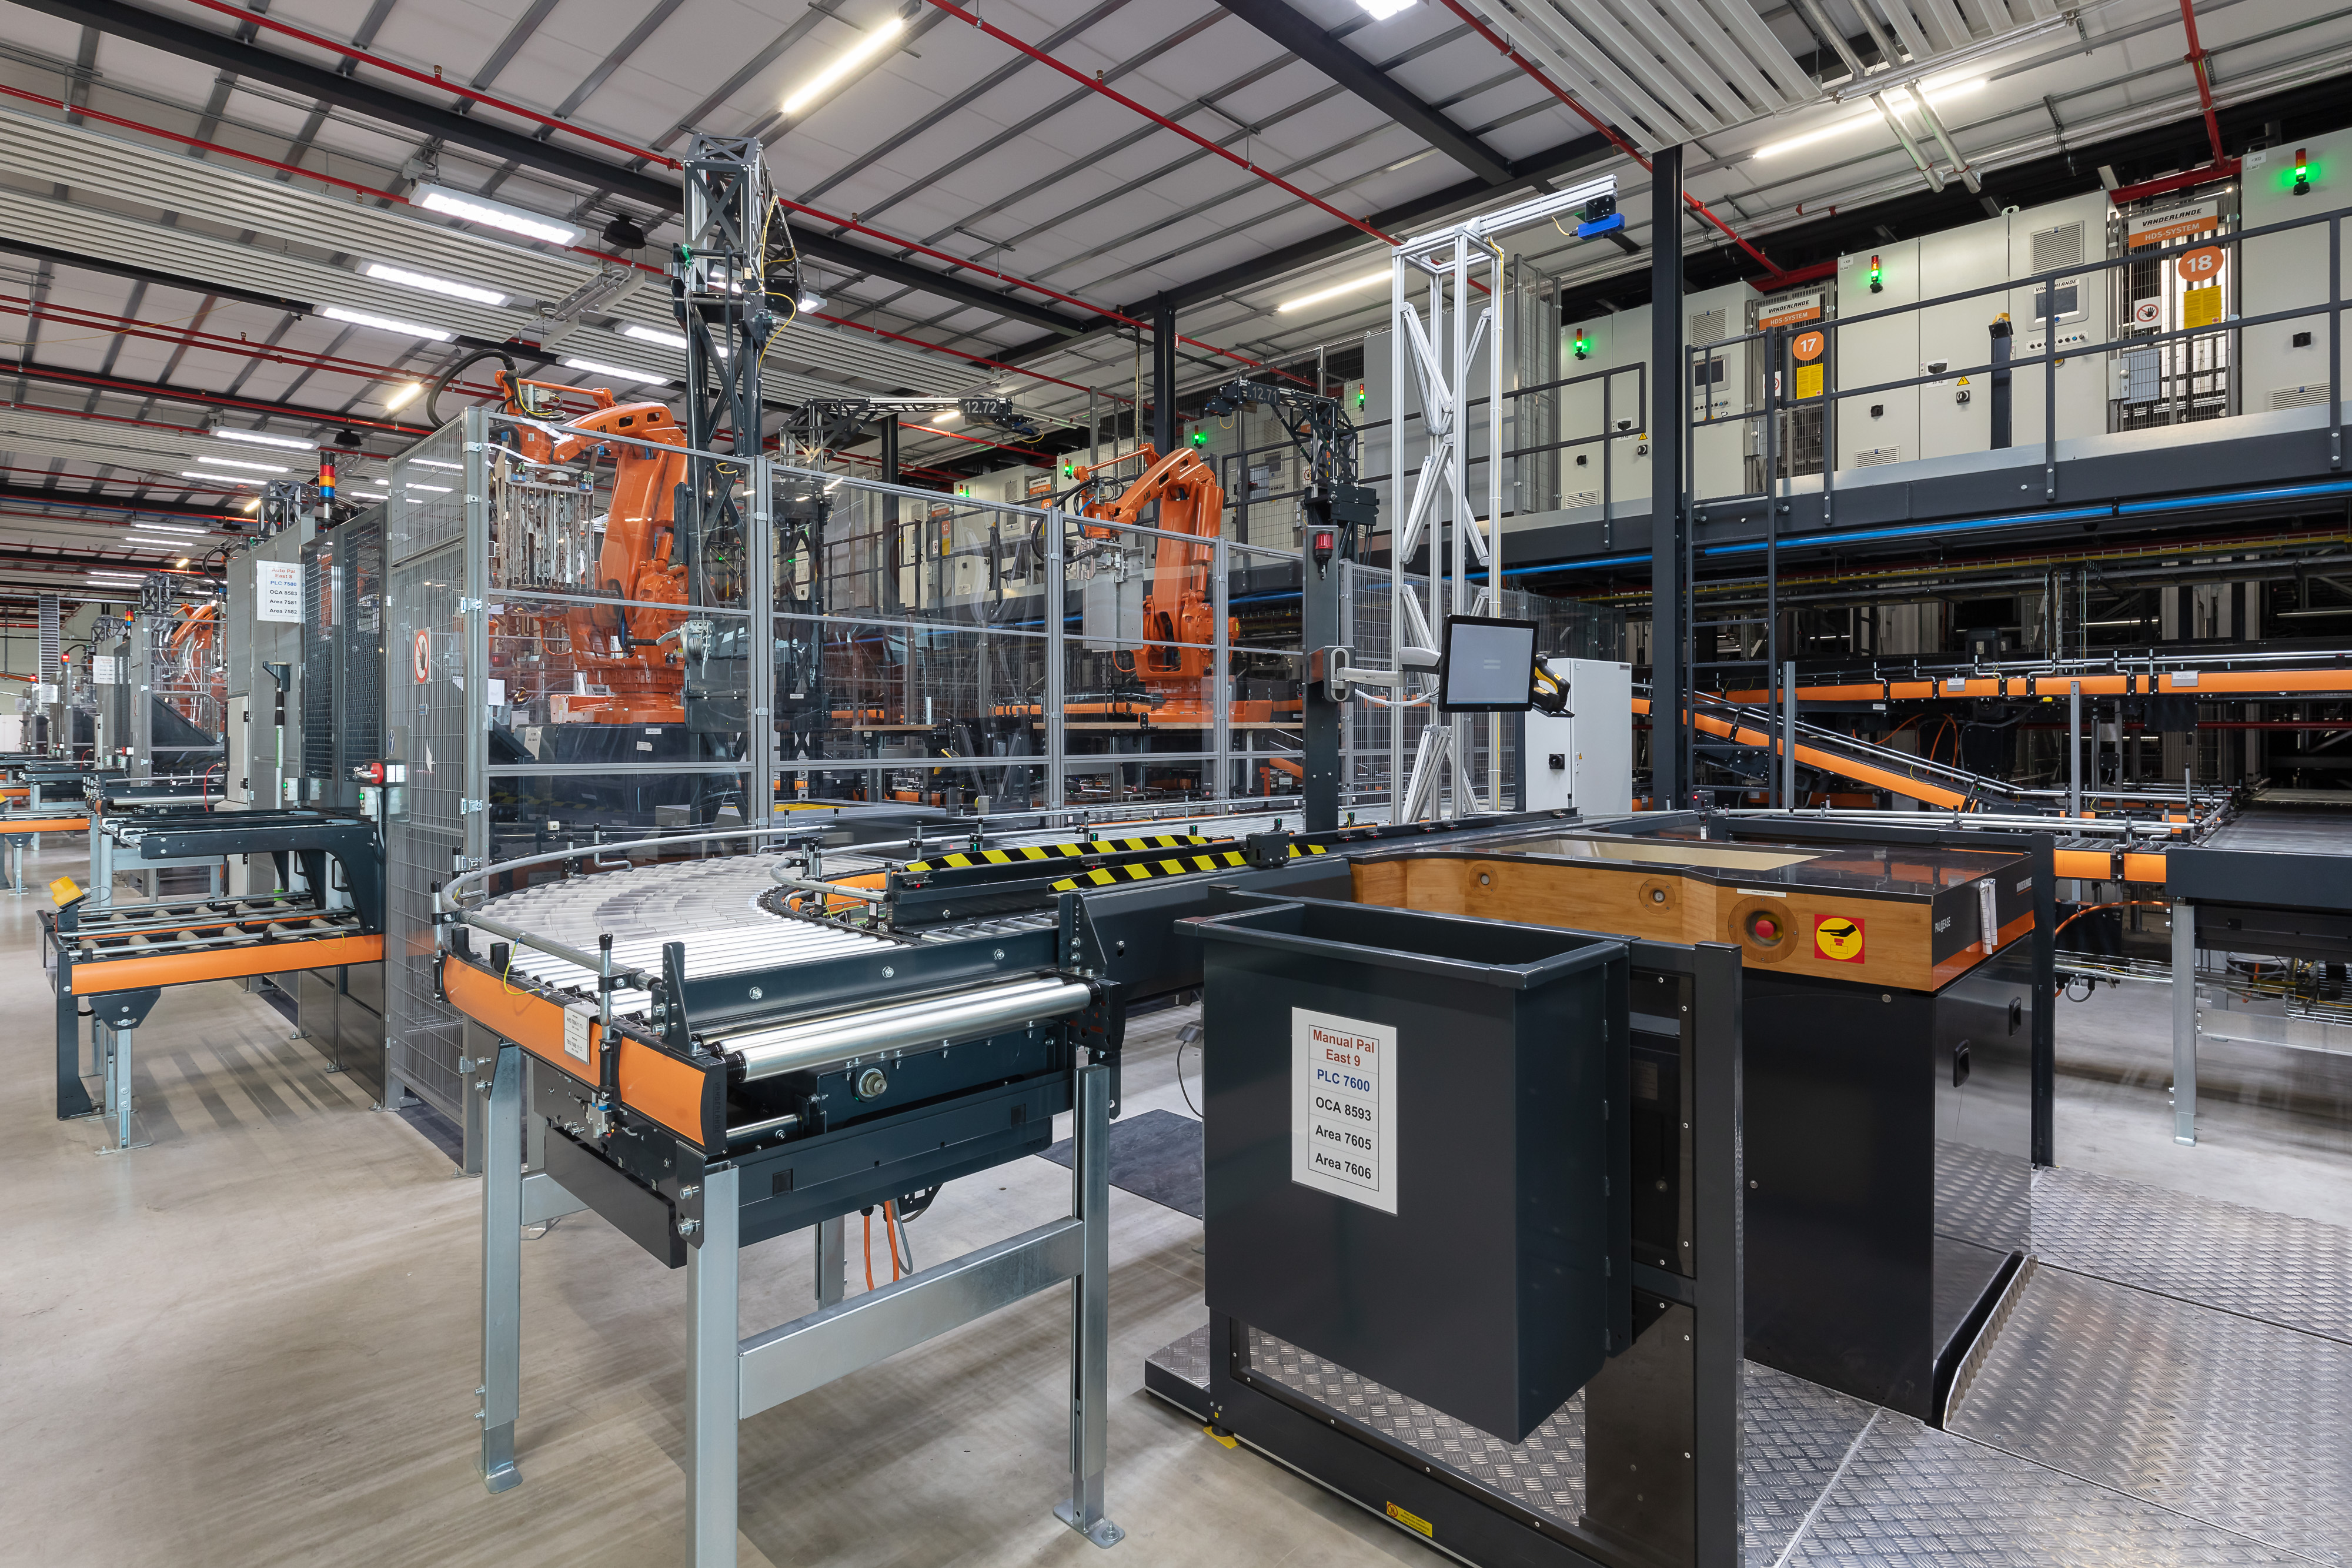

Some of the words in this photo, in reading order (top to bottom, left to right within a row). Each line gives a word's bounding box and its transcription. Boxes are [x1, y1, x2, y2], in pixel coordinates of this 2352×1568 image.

[2143, 208, 2202, 227] VANDERLANDE
[2145, 223, 2200, 241] HDS-SYSTEM
[2187, 255, 2213, 273] 18
[1769, 300, 1810, 313] VANDERLANDE
[1770, 312, 1808, 325] HDS-SYSTEM
[1800, 337, 1817, 352] 17
[1313, 1029, 1353, 1049] Manual
[1356, 1039, 1375, 1054] Pal
[1326, 1048, 1351, 1065] East
[1354, 1055, 1361, 1066] 9
[1317, 1069, 1340, 1084] PLC
[1344, 1075, 1370, 1092] 7600
[1315, 1096, 1341, 1114] OCA
[1345, 1104, 1371, 1121] 8593
[1315, 1125, 1341, 1142] Area
[1345, 1132, 1371, 1151] 7605
[1315, 1152, 1341, 1171] Area
[1345, 1161, 1371, 1179] 7606
